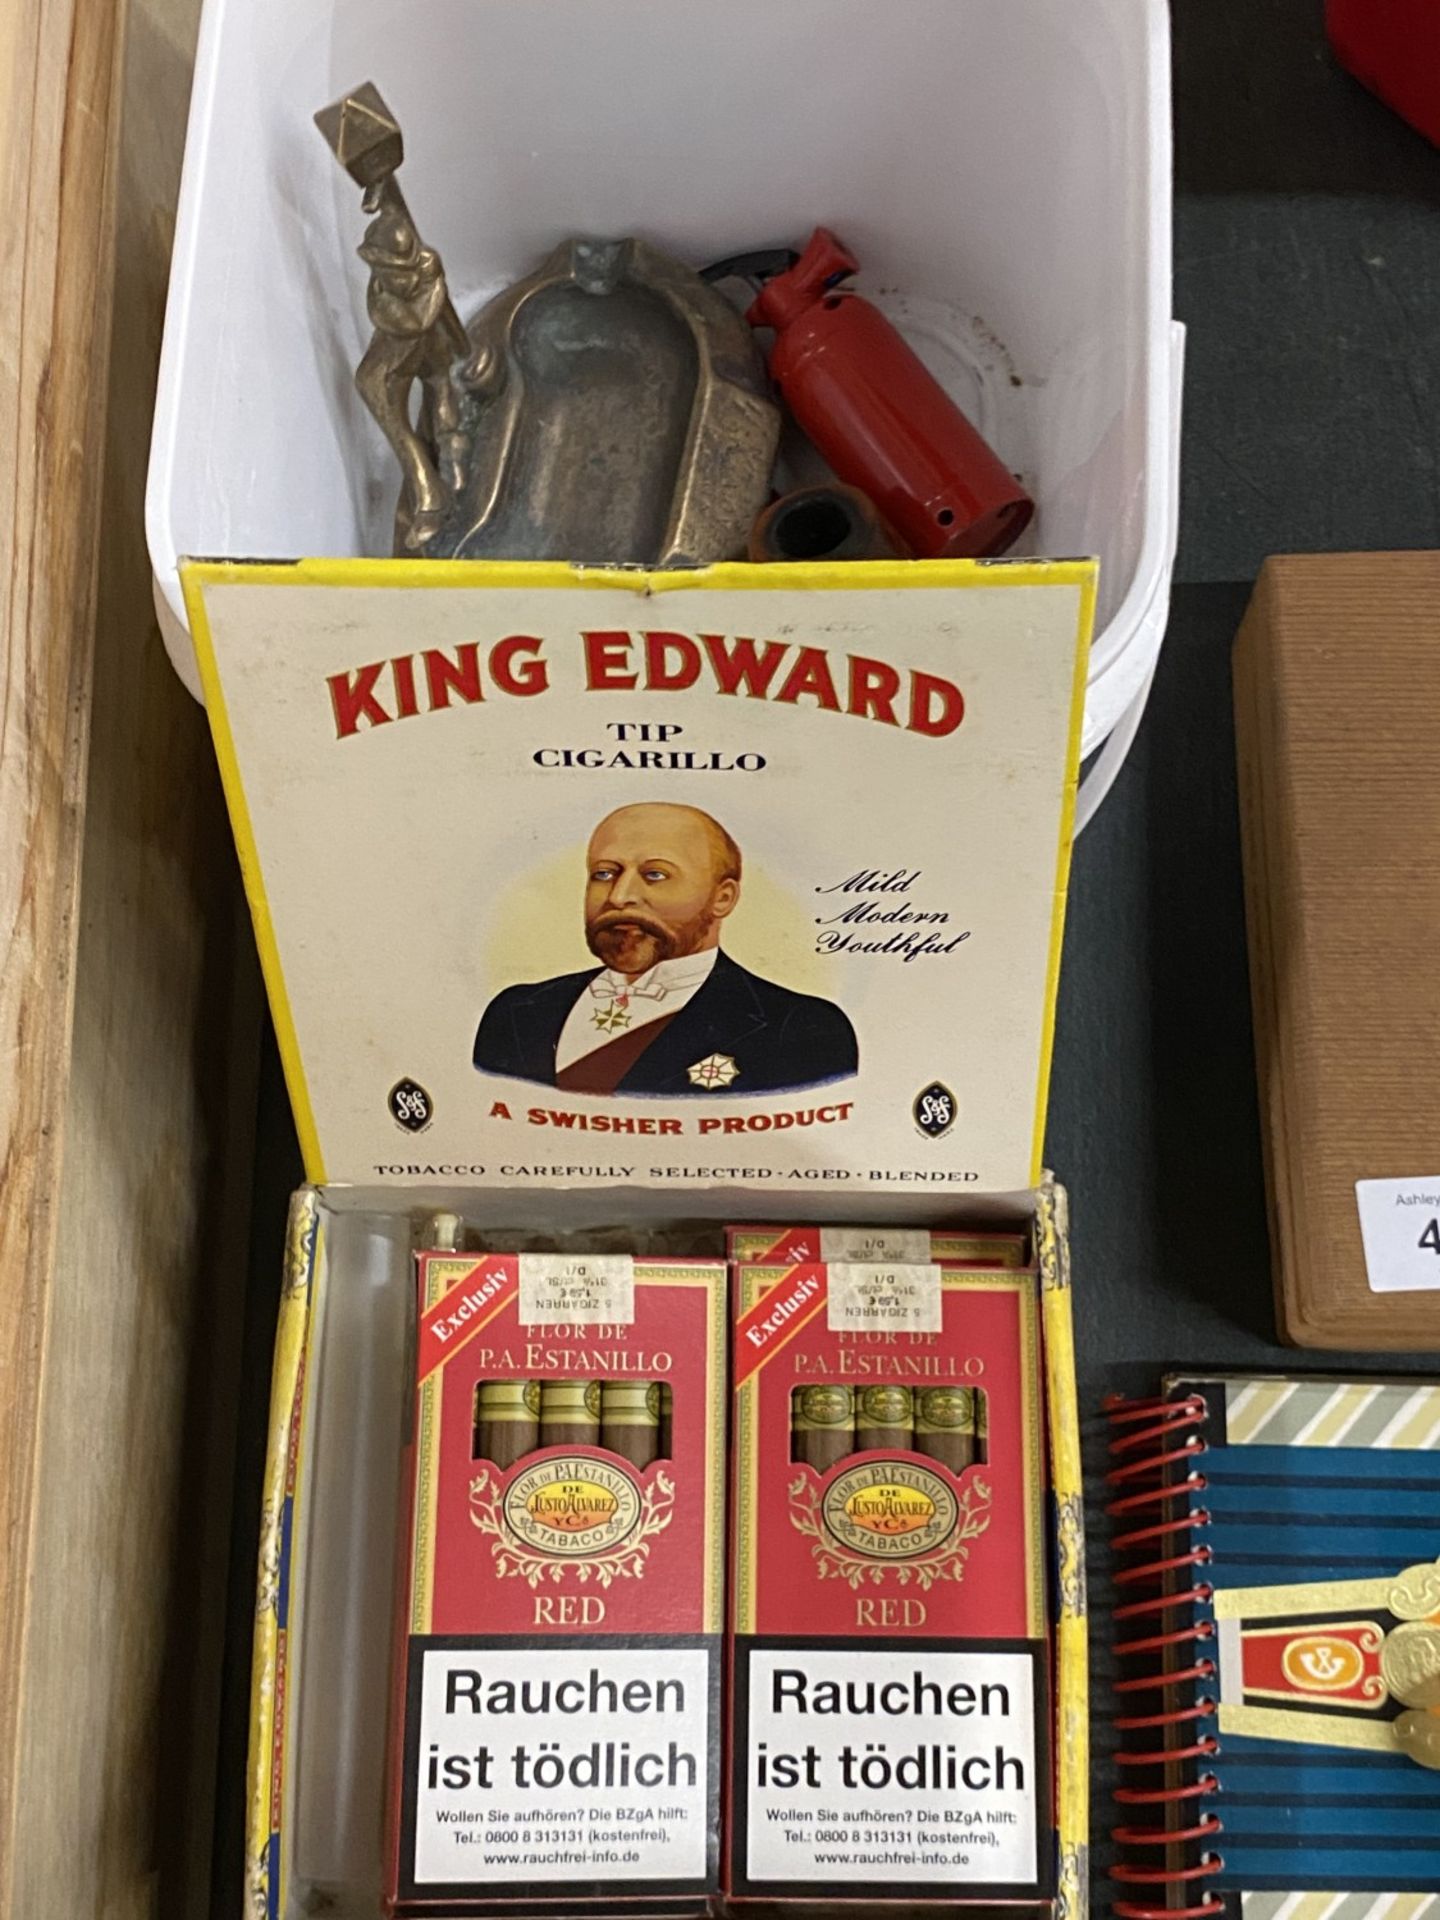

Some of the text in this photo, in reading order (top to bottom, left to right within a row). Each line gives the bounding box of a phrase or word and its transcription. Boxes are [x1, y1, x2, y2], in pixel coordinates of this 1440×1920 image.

[325, 630, 965, 740] KING EDWARD
[607, 723, 683, 742] TIP
[533, 749, 767, 771] CIGARILLO
[815, 869, 922, 893] Mild
[815, 901, 949, 924] Modern
[815, 930, 971, 963] Youthful
[489, 1102, 853, 1135] A SWISHER PRODUCT
[373, 1165, 485, 1176] TOBACCO
[500, 1165, 635, 1177] CAREFULLY
[430, 1267, 508, 1343] Exclusiv
[535, 1300, 599, 1309] ZIGARREN
[745, 1274, 821, 1349] Exclusiv
[845, 1307, 908, 1317] ZIGARREN
[527, 1325, 628, 1339] FLOR DE
[839, 1331, 937, 1345] FLOR DE
[511, 1477, 538, 1510] FLOR
[829, 1481, 855, 1512] FLOR
[540, 1529, 603, 1546] TABACO
[860, 1533, 921, 1549] TABACO
[533, 1597, 606, 1625] RED
[856, 1599, 927, 1627] RED
[445, 1669, 685, 1714] Rauchen
[772, 1669, 1010, 1716] Rauchen
[428, 1742, 697, 1789] ist tödlich
[758, 1743, 1024, 1790] ist tödlich
[437, 1807, 688, 1823] Wollen Sie aufhören? Die BZgA hilft:
[767, 1809, 1017, 1825] Wollen Sie aufhören? Die BZgA hilft:
[453, 1831, 481, 1843] Tel.:
[485, 1831, 518, 1843] 0800
[523, 1831, 531, 1843] 8
[535, 1831, 583, 1843] 313131
[784, 1830, 811, 1842] Tel.:
[815, 1830, 848, 1842] 0800
[852, 1831, 860, 1842] 8
[864, 1831, 912, 1843] 313131
[484, 1850, 640, 1864] www.rauchfrei-info.de
[815, 1852, 969, 1865] www.rauchfrei-info.de
